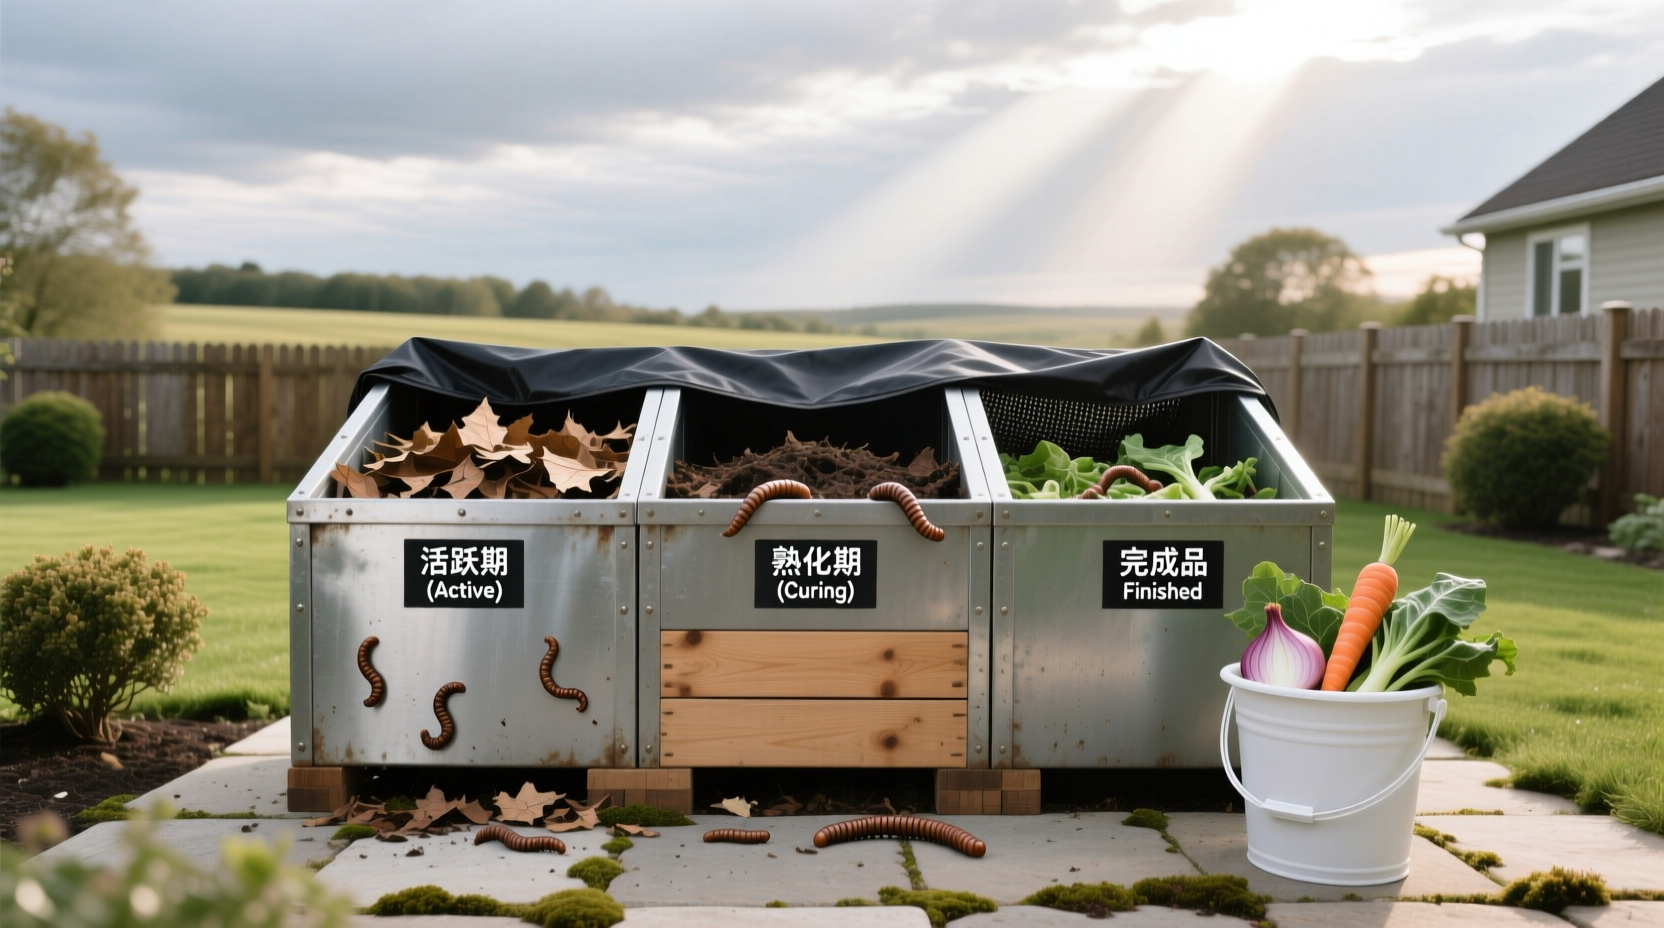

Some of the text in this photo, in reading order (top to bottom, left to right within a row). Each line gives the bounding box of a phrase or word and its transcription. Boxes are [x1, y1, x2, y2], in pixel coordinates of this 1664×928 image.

[420, 546, 508, 577] 活跃期
[771, 546, 861, 577] 熟化期
[1119, 546, 1208, 577] 完成品
[427, 580, 503, 604] (Active)
[777, 580, 855, 605] (Curing)
[1124, 581, 1203, 601] Finished
